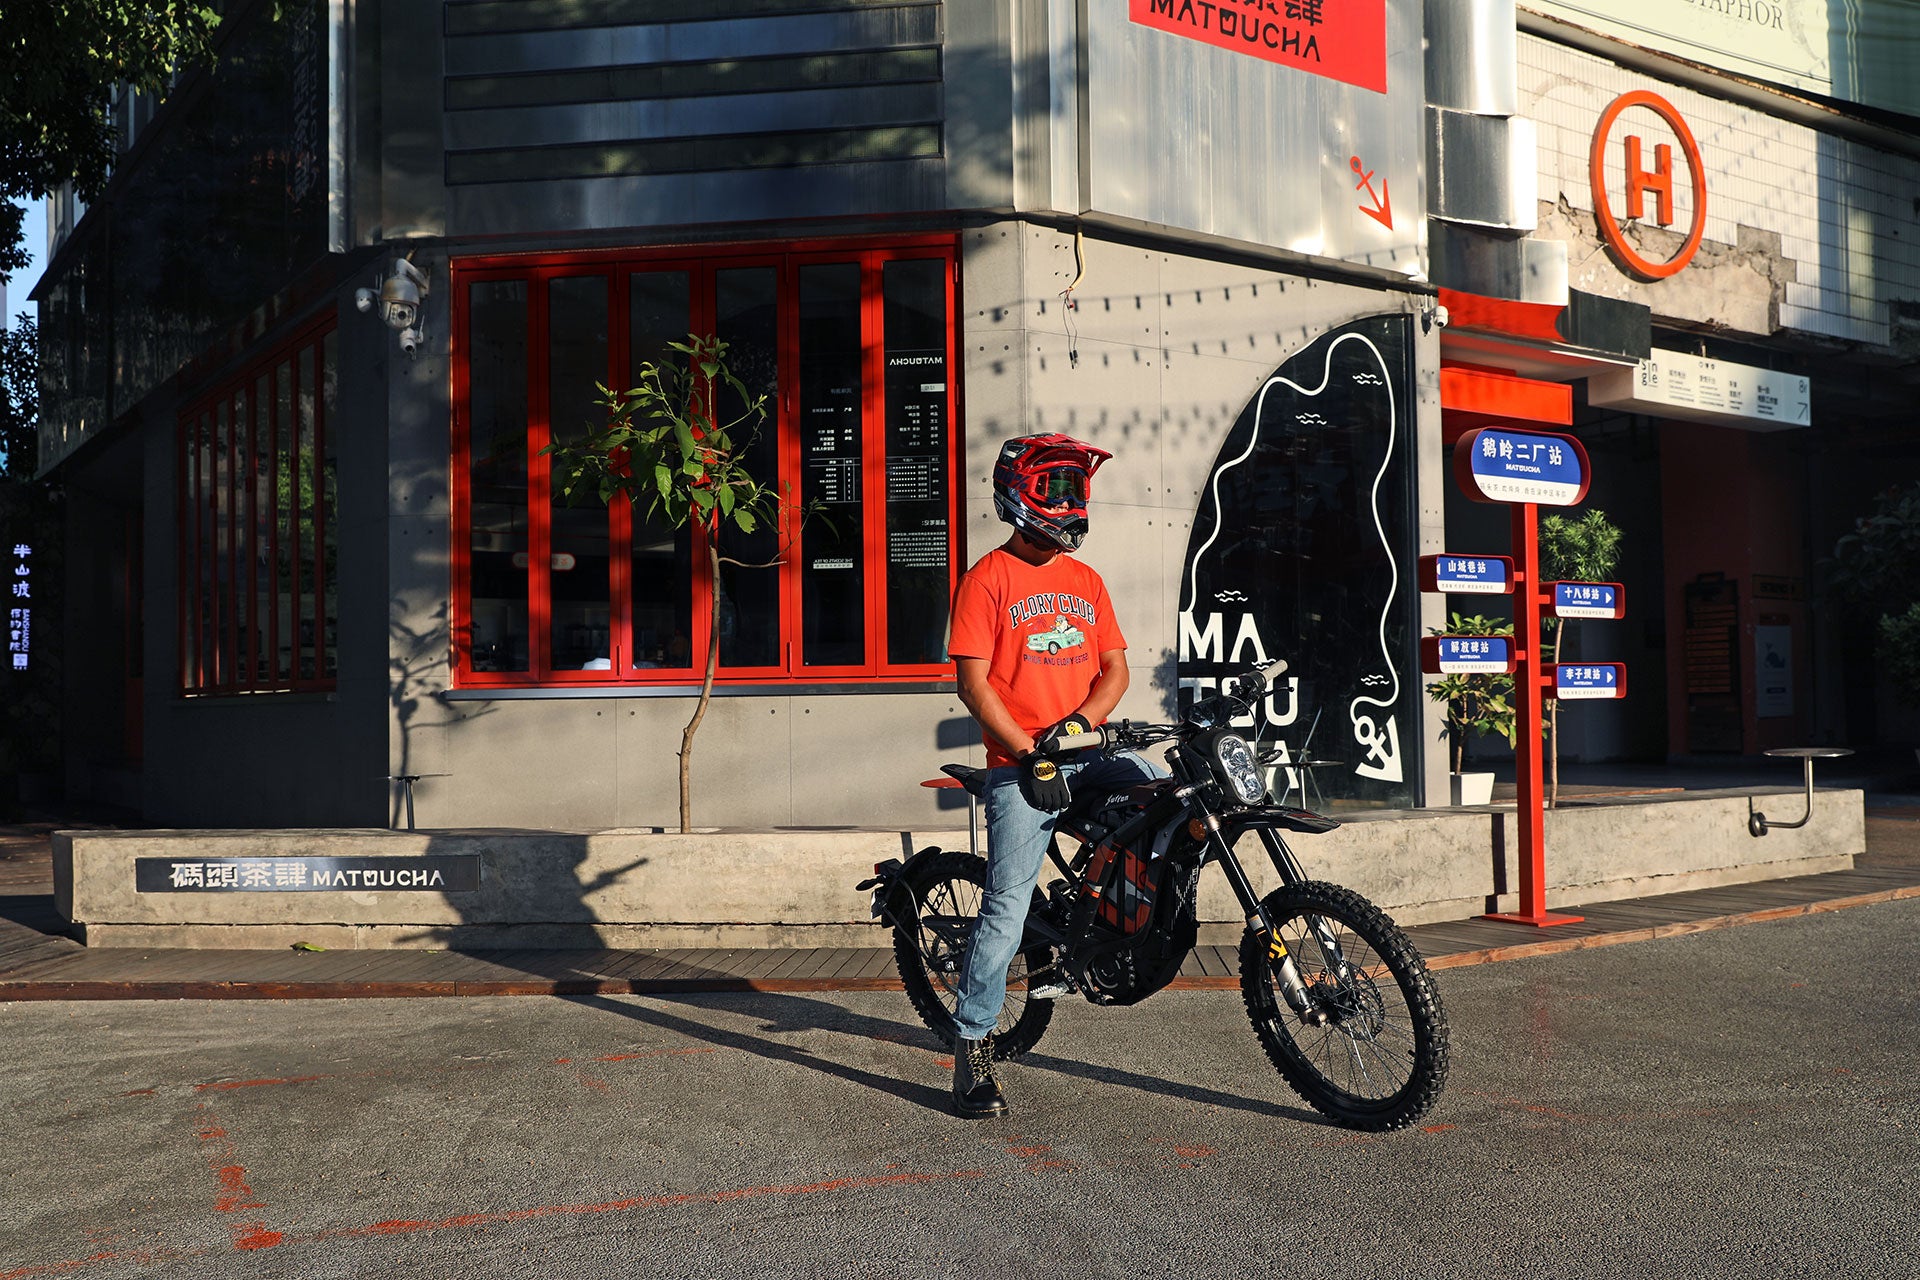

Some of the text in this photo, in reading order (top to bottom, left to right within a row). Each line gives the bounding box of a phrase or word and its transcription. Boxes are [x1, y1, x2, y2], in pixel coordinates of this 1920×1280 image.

[1149, 0, 1321, 62] MATOUCHA
[1482, 437, 1562, 465] 鹅岭二厂站
[1505, 463, 1541, 473] MATOUCHA
[1448, 559, 1486, 574] 山城巷站
[1564, 586, 1600, 599] 十八梯站
[1008, 592, 1096, 630] PLORY CLUB
[1179, 612, 1268, 663] MA
[1450, 640, 1489, 653] 解放碑站
[313, 869, 445, 887] MATOUCHA
